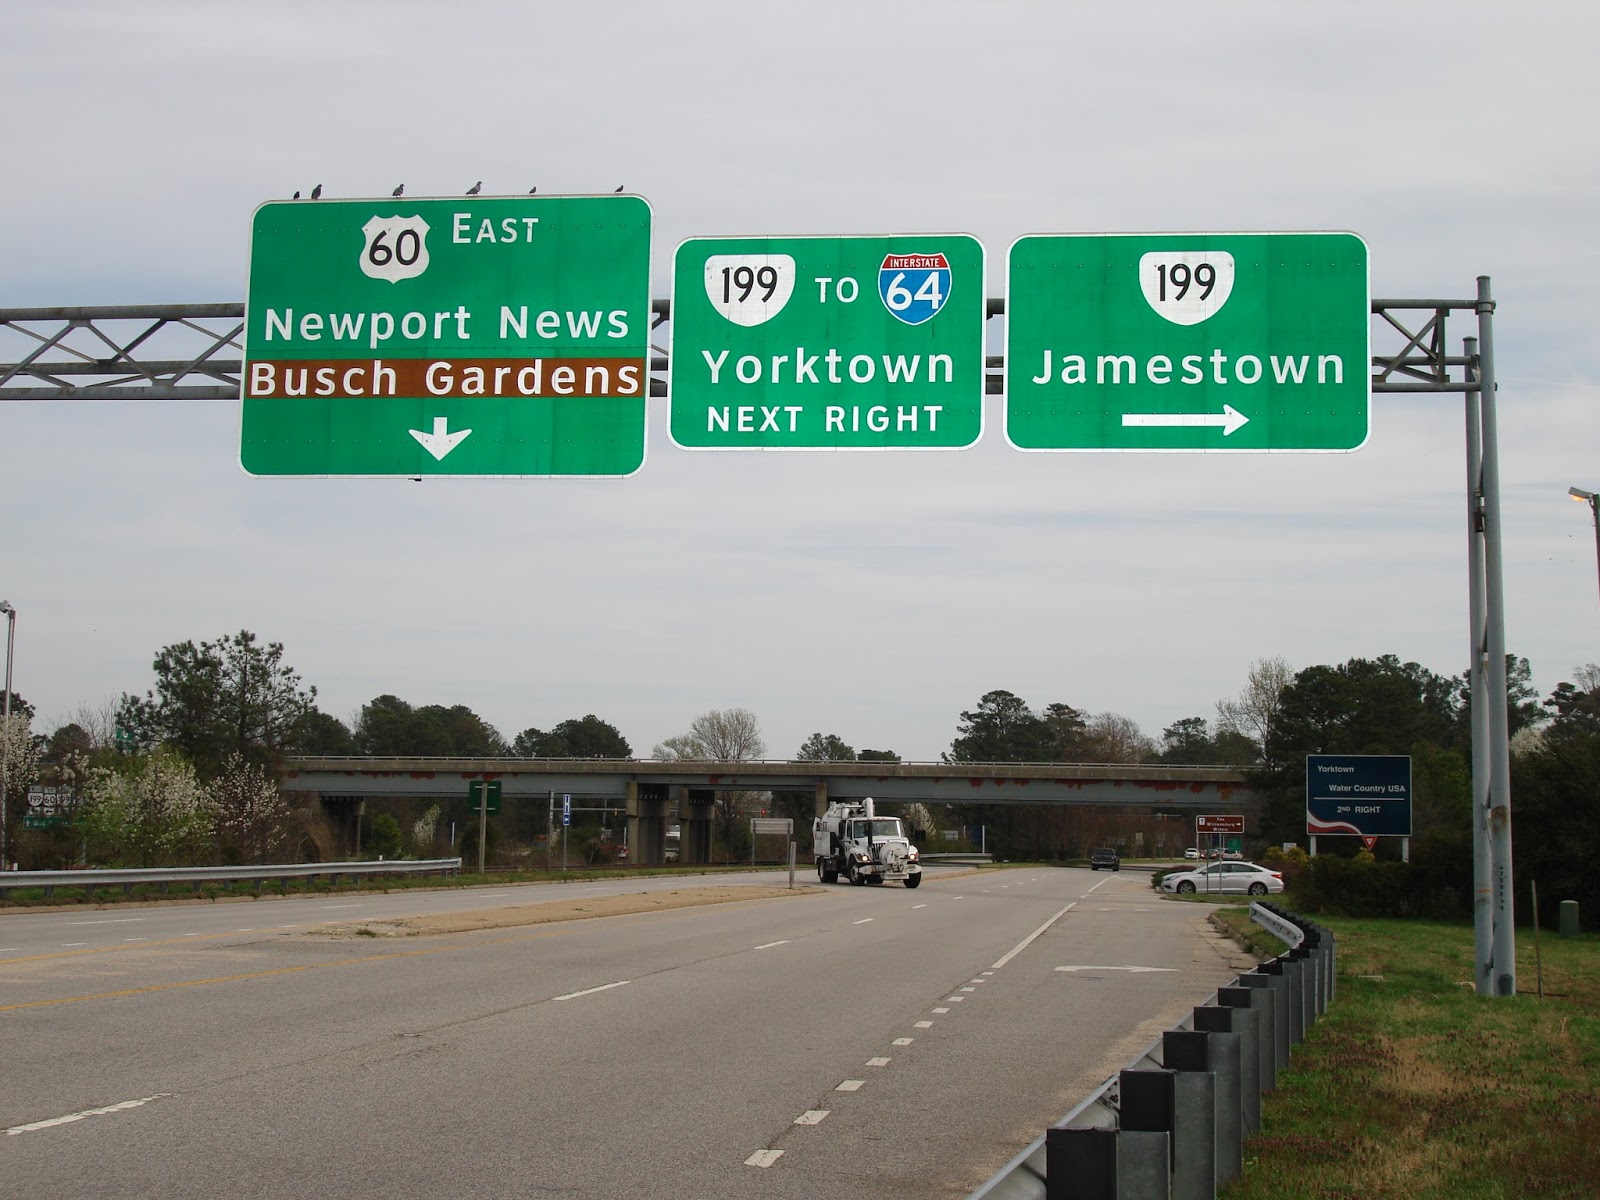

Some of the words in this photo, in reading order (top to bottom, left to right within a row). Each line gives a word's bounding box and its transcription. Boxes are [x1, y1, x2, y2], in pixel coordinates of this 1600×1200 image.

[369, 230, 420, 265] 60
[453, 213, 539, 244] EAST
[890, 258, 940, 268] INTERSTATE
[722, 267, 777, 303] 199
[815, 277, 859, 303] TO
[886, 271, 943, 311] 64
[1157, 264, 1216, 302] 199
[265, 306, 471, 349] Newport
[500, 306, 629, 339] News
[251, 360, 396, 396] Busch
[426, 359, 639, 395] Gardens
[702, 348, 953, 384] Yorktown
[1033, 349, 1343, 385] Jamestown
[708, 406, 802, 432] NEXT
[826, 405, 943, 432] RIGHT
[1317, 765, 1355, 773] Yorktown
[30, 795, 42, 803] 199
[44, 796, 56, 804] 60
[1329, 784, 1352, 792] Water
[1353, 784, 1386, 794] Country
